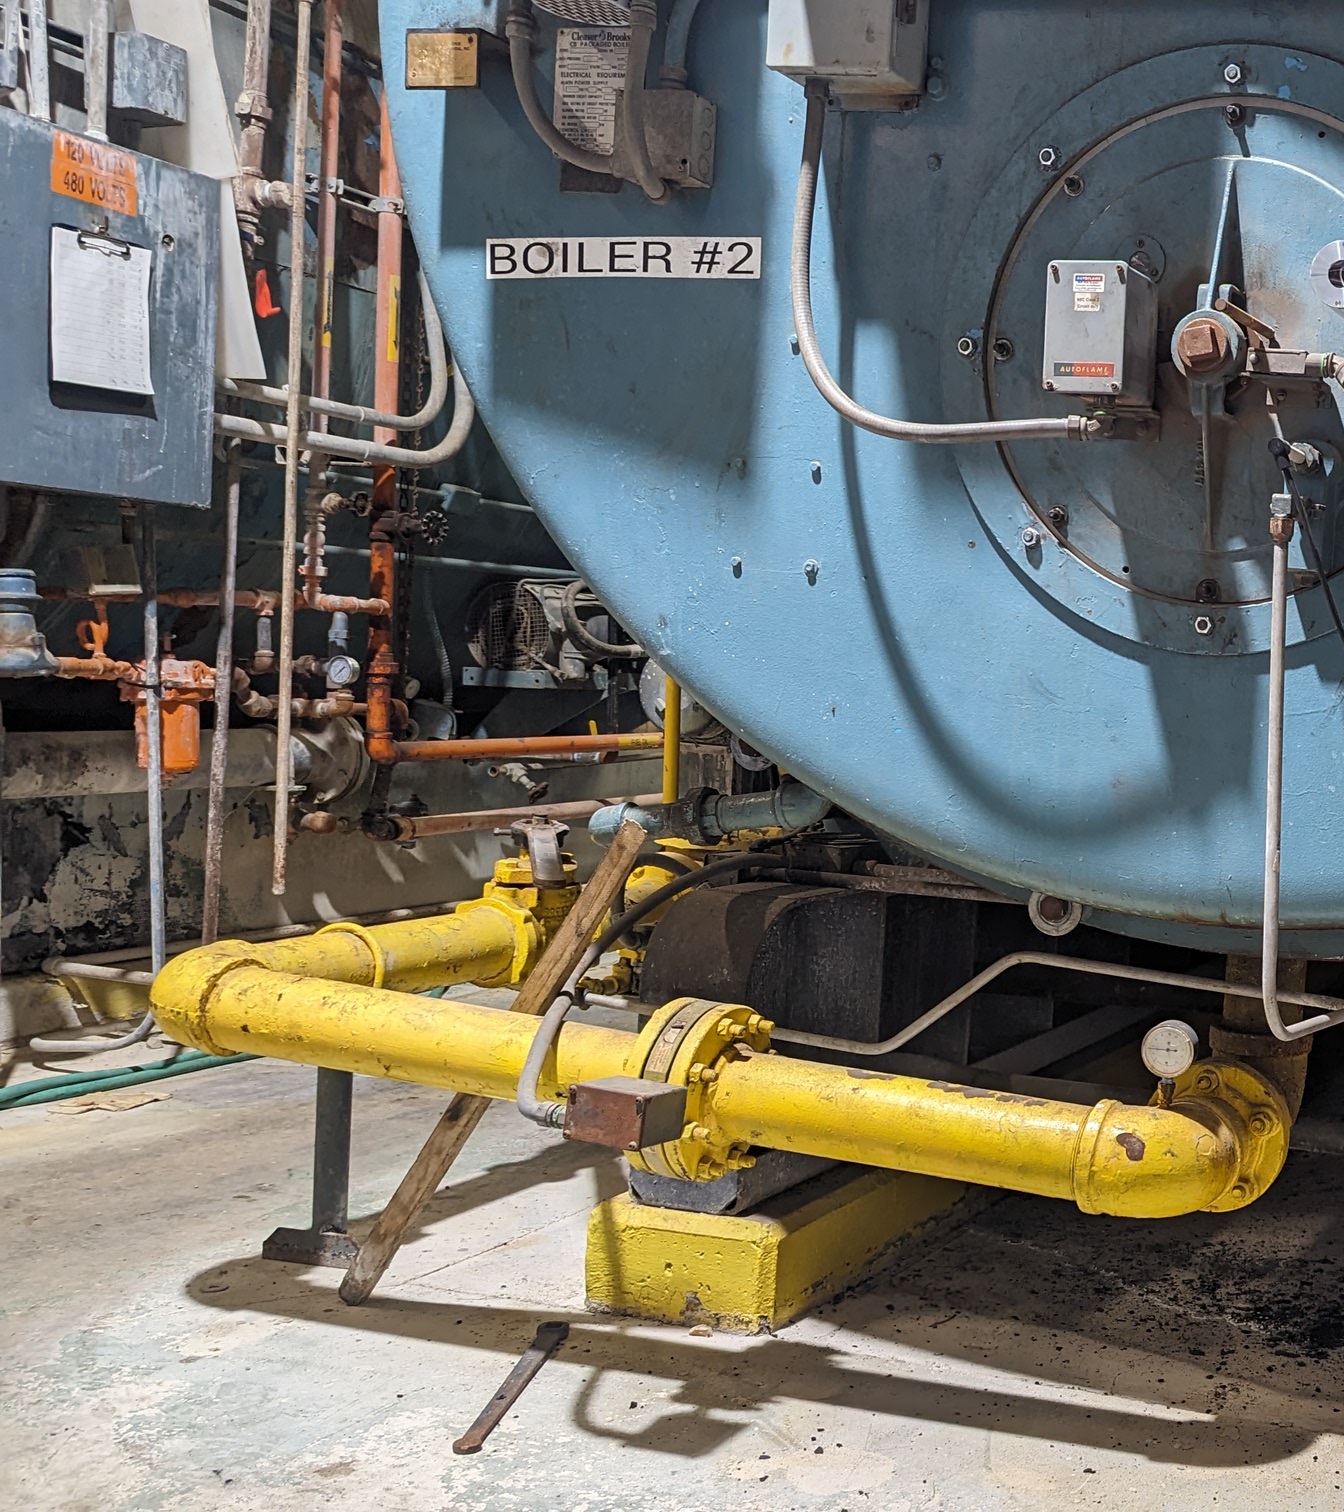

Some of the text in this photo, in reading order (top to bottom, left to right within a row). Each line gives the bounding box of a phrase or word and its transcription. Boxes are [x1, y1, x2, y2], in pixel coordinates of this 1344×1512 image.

[571, 31, 599, 41] Cleaver
[65, 139, 84, 163] 120
[63, 170, 126, 208] 480 VOLTS
[489, 240, 755, 275] BOILER #2
[1060, 365, 1109, 374] AUTOFLAME
